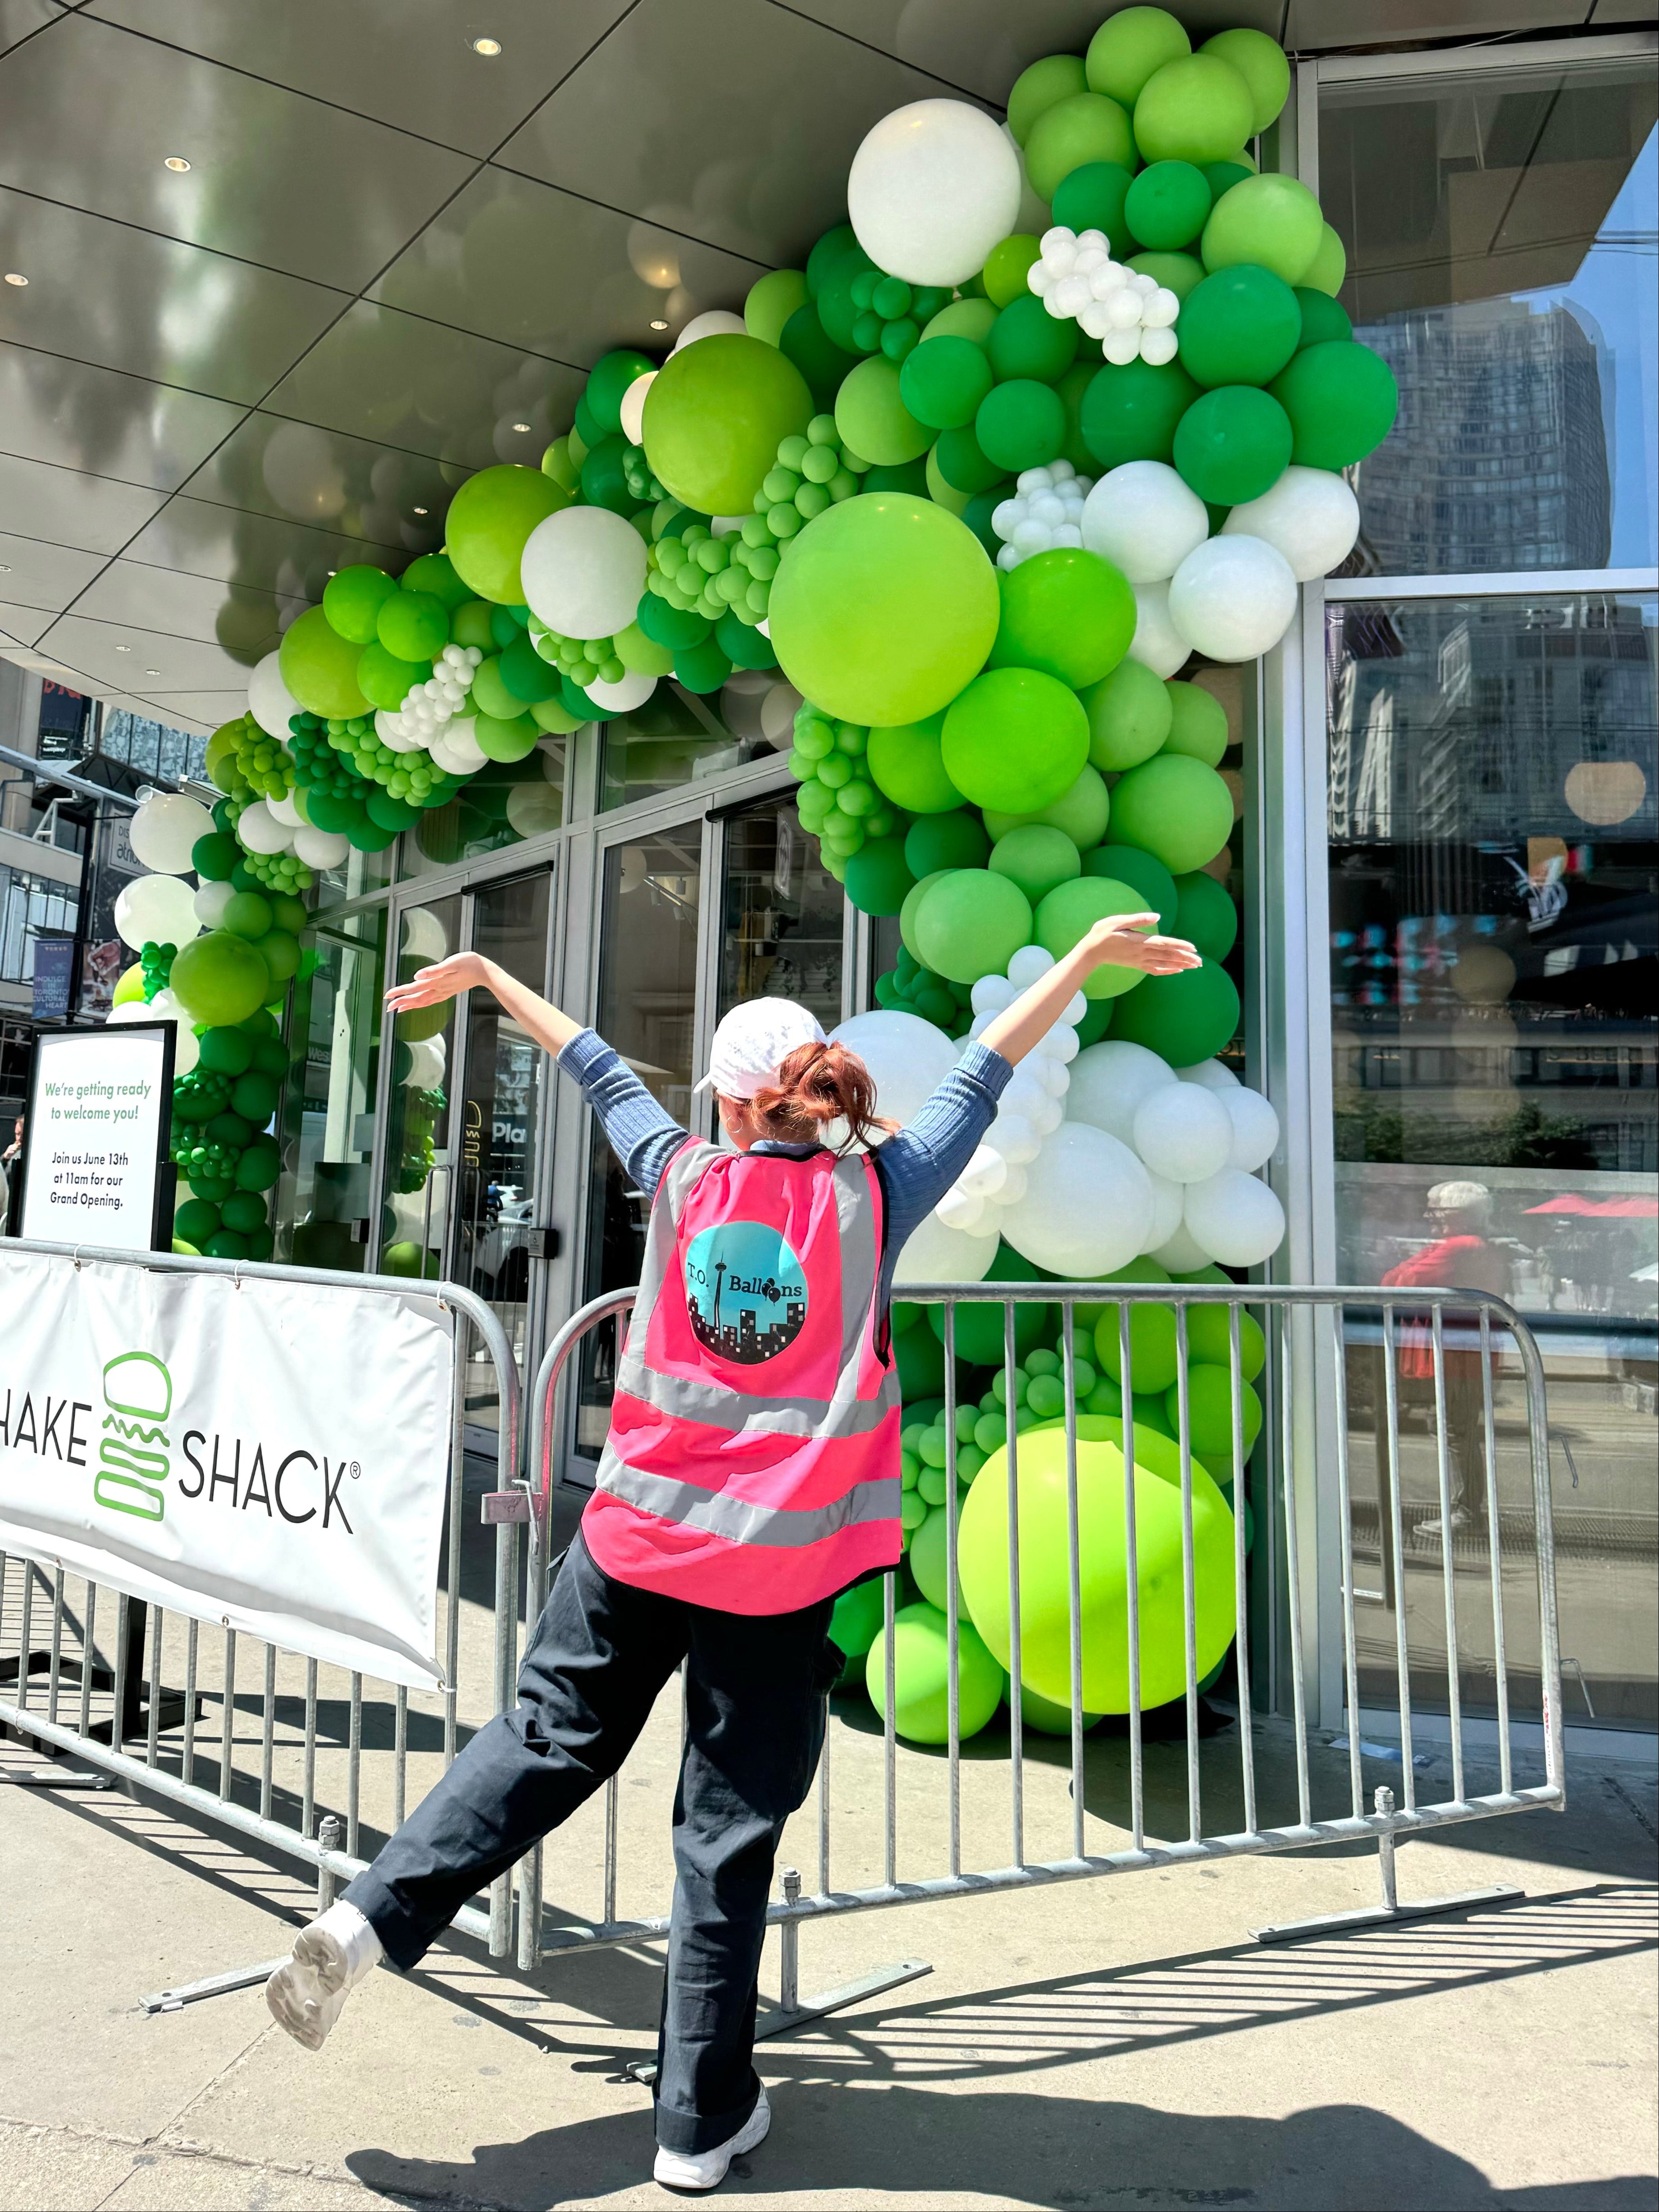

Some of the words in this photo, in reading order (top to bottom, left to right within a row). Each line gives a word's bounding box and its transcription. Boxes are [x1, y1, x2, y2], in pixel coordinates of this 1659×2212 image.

[46, 1083, 74, 1096] We’re
[77, 1081, 114, 1099] getting
[117, 1080, 151, 1099] ready
[51, 1107, 61, 1119] to
[64, 1104, 110, 1119] welcome
[113, 1105, 138, 1123] you!
[52, 1151, 69, 1163] Join
[72, 1156, 82, 1164] us
[84, 1153, 105, 1164] June
[109, 1152, 128, 1165] 13th
[54, 1173, 63, 1183] at
[66, 1172, 88, 1184] 11am
[91, 1172, 104, 1185] for
[107, 1177, 123, 1186] our
[50, 1191, 78, 1204] Grand
[80, 1193, 123, 1210] Opening.
[688, 1262, 709, 1287] T.O.
